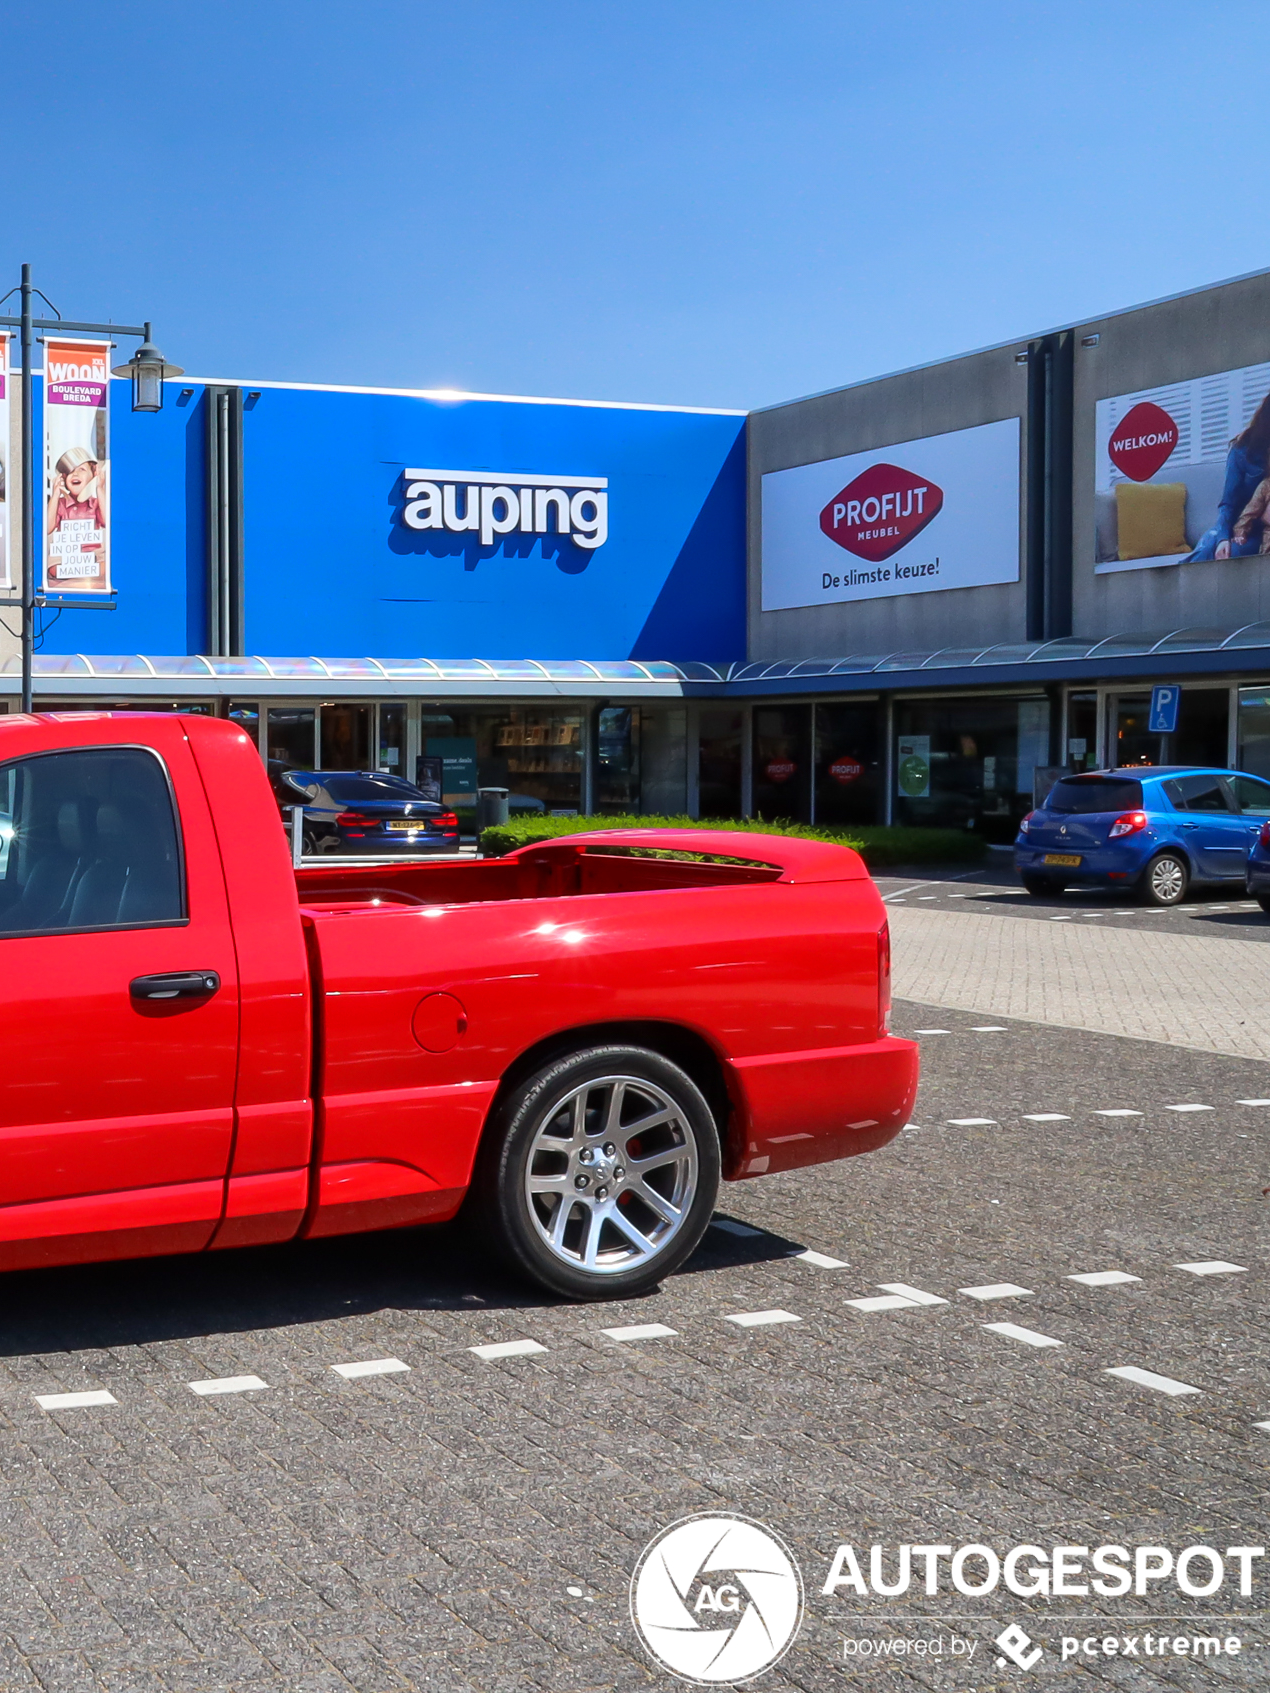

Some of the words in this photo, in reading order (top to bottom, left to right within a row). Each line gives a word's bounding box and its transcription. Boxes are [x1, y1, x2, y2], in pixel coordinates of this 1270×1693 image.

[48, 361, 105, 381] WOON
[52, 385, 102, 396] BOULEVARD
[63, 393, 91, 403] BREDA
[1113, 430, 1173, 452] WELKOM!
[404, 468, 608, 549] auping
[833, 486, 928, 529] PROFIJT
[63, 521, 92, 531] RICHT
[56, 533, 67, 543] JE
[69, 532, 101, 543] LEVEN
[857, 526, 900, 541] MEUBEL
[52, 545, 63, 554] IN
[65, 544, 79, 553] OP
[64, 555, 92, 565] JOUW
[59, 565, 97, 576] MANIER
[822, 571, 841, 589] De
[843, 566, 891, 586] slimste
[894, 557, 940, 580] keuze!
[1156, 689, 1172, 712] P
